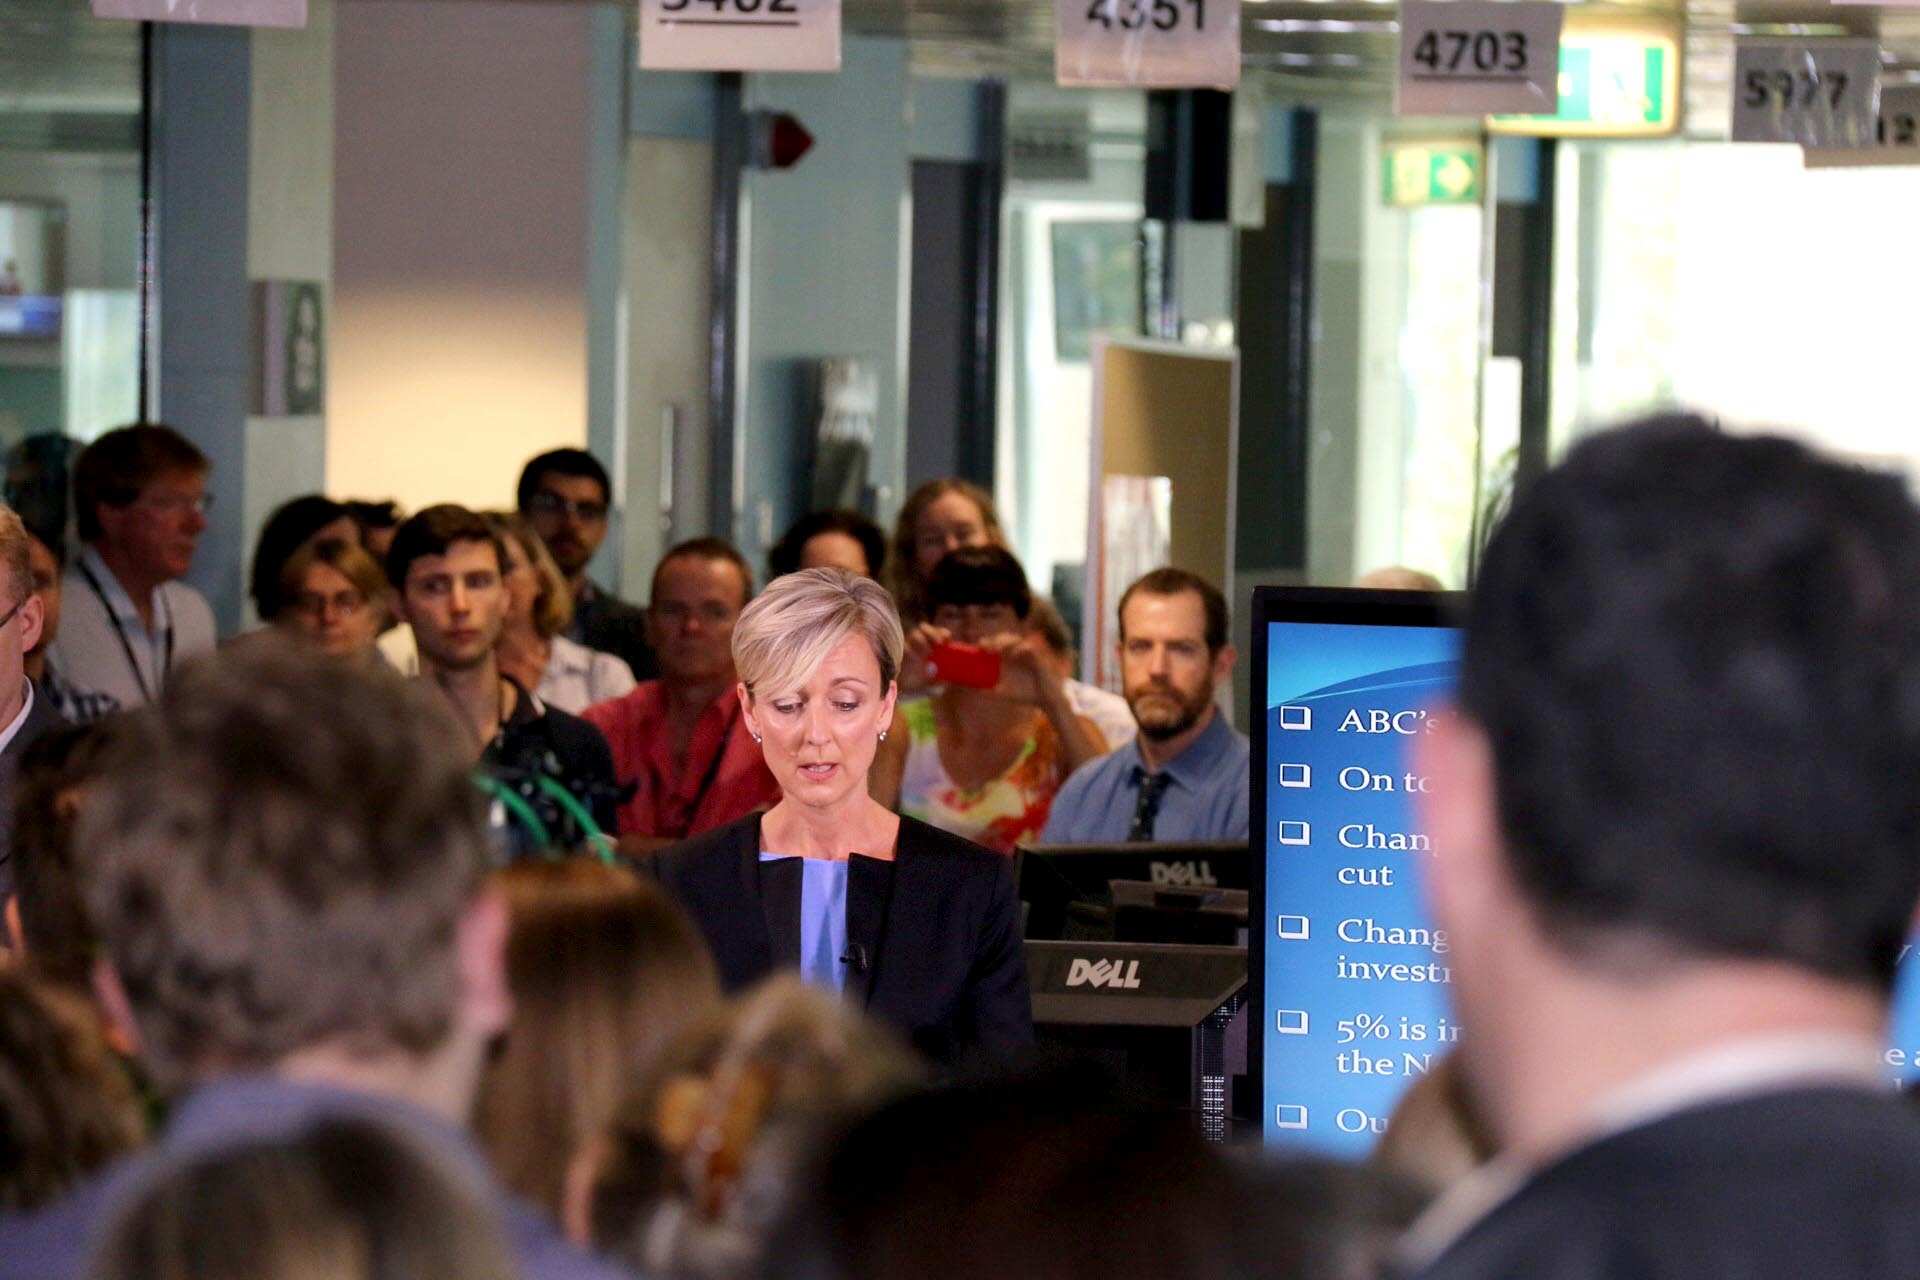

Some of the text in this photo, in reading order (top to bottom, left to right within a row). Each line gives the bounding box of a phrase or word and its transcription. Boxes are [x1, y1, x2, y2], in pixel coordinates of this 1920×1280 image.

[1412, 30, 1529, 71] 4703
[1338, 766, 1395, 792] On
[1338, 824, 1440, 858] Chan
[1150, 860, 1218, 886] DELL
[1338, 865, 1394, 886] cut
[1065, 958, 1141, 989] DELL
[1336, 1013, 1391, 1043] 5%
[1400, 1016, 1427, 1041] is
[1336, 1049, 1394, 1076] the
